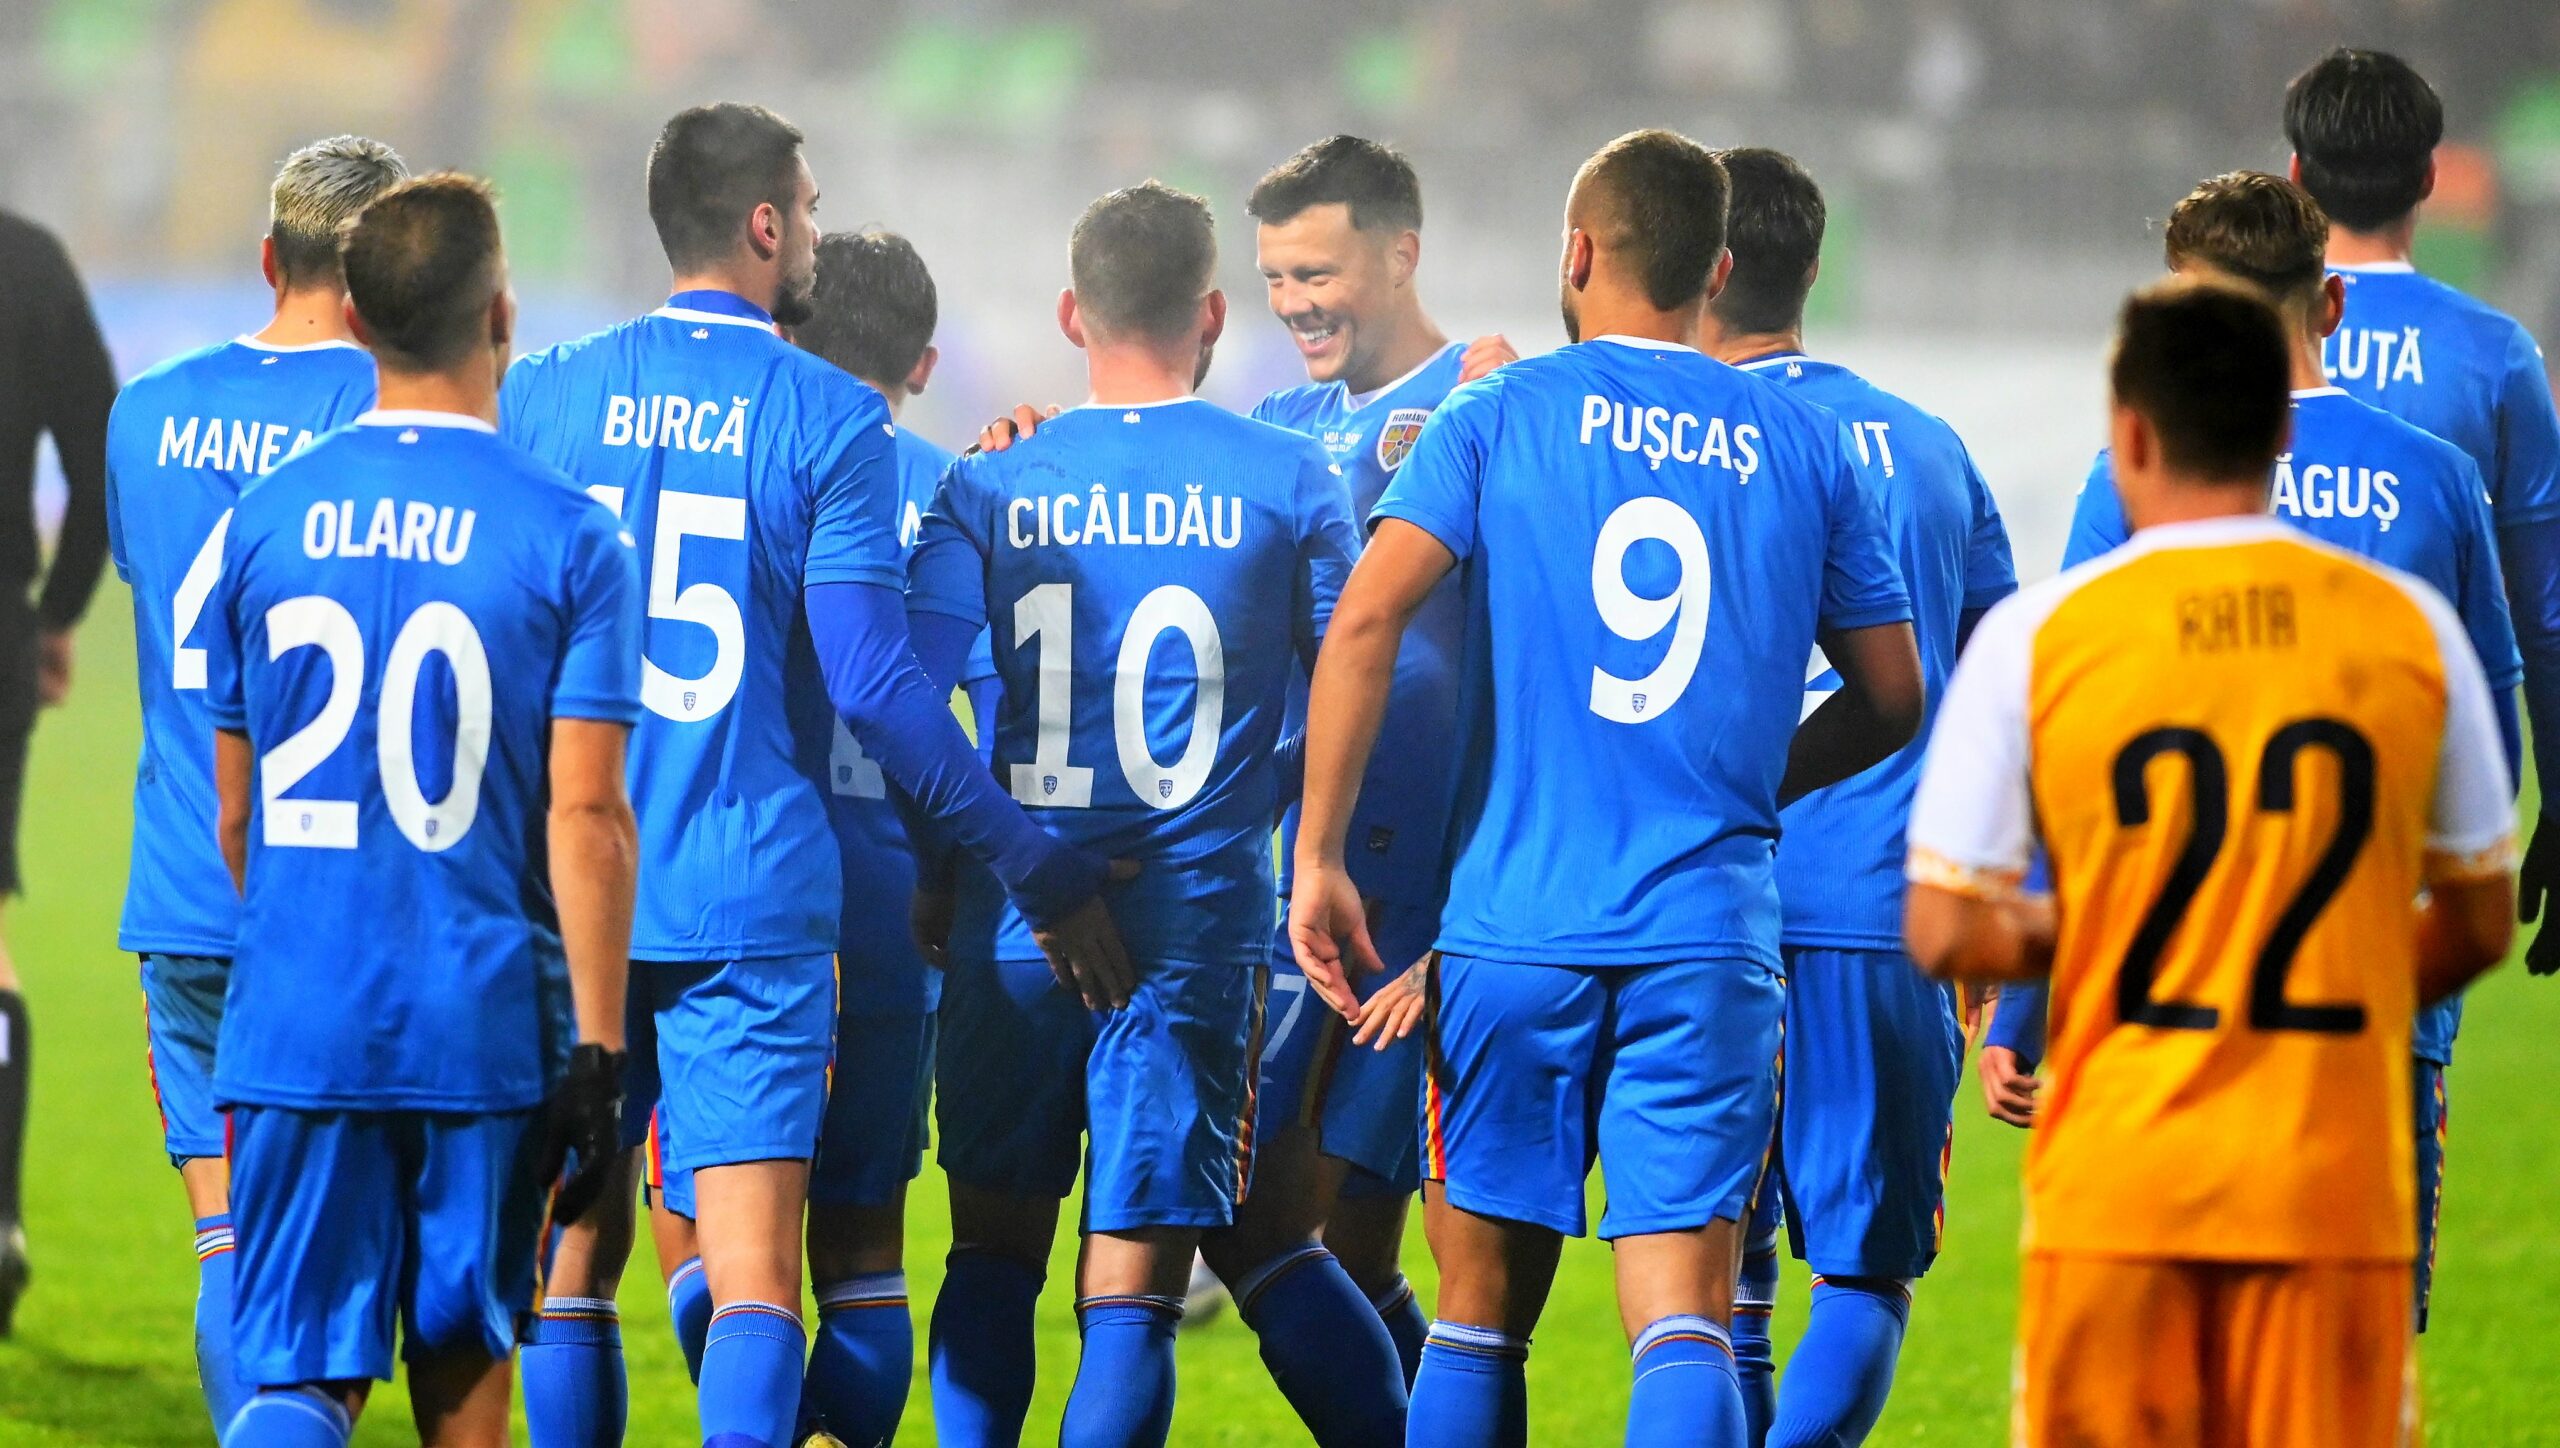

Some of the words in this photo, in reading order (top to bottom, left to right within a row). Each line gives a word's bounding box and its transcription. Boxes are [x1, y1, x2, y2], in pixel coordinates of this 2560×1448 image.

[302, 497, 476, 565] OLARU
[602, 395, 750, 457] BURCĂ
[1006, 483, 1244, 549] CICÂLDĂU
[1580, 394, 1761, 486] PUȘCAȘ
[585, 484, 747, 724] 5
[1009, 582, 1226, 811] 10
[1588, 496, 1712, 724] 9
[260, 595, 493, 852] 20
[2111, 717, 2378, 1035] 22
